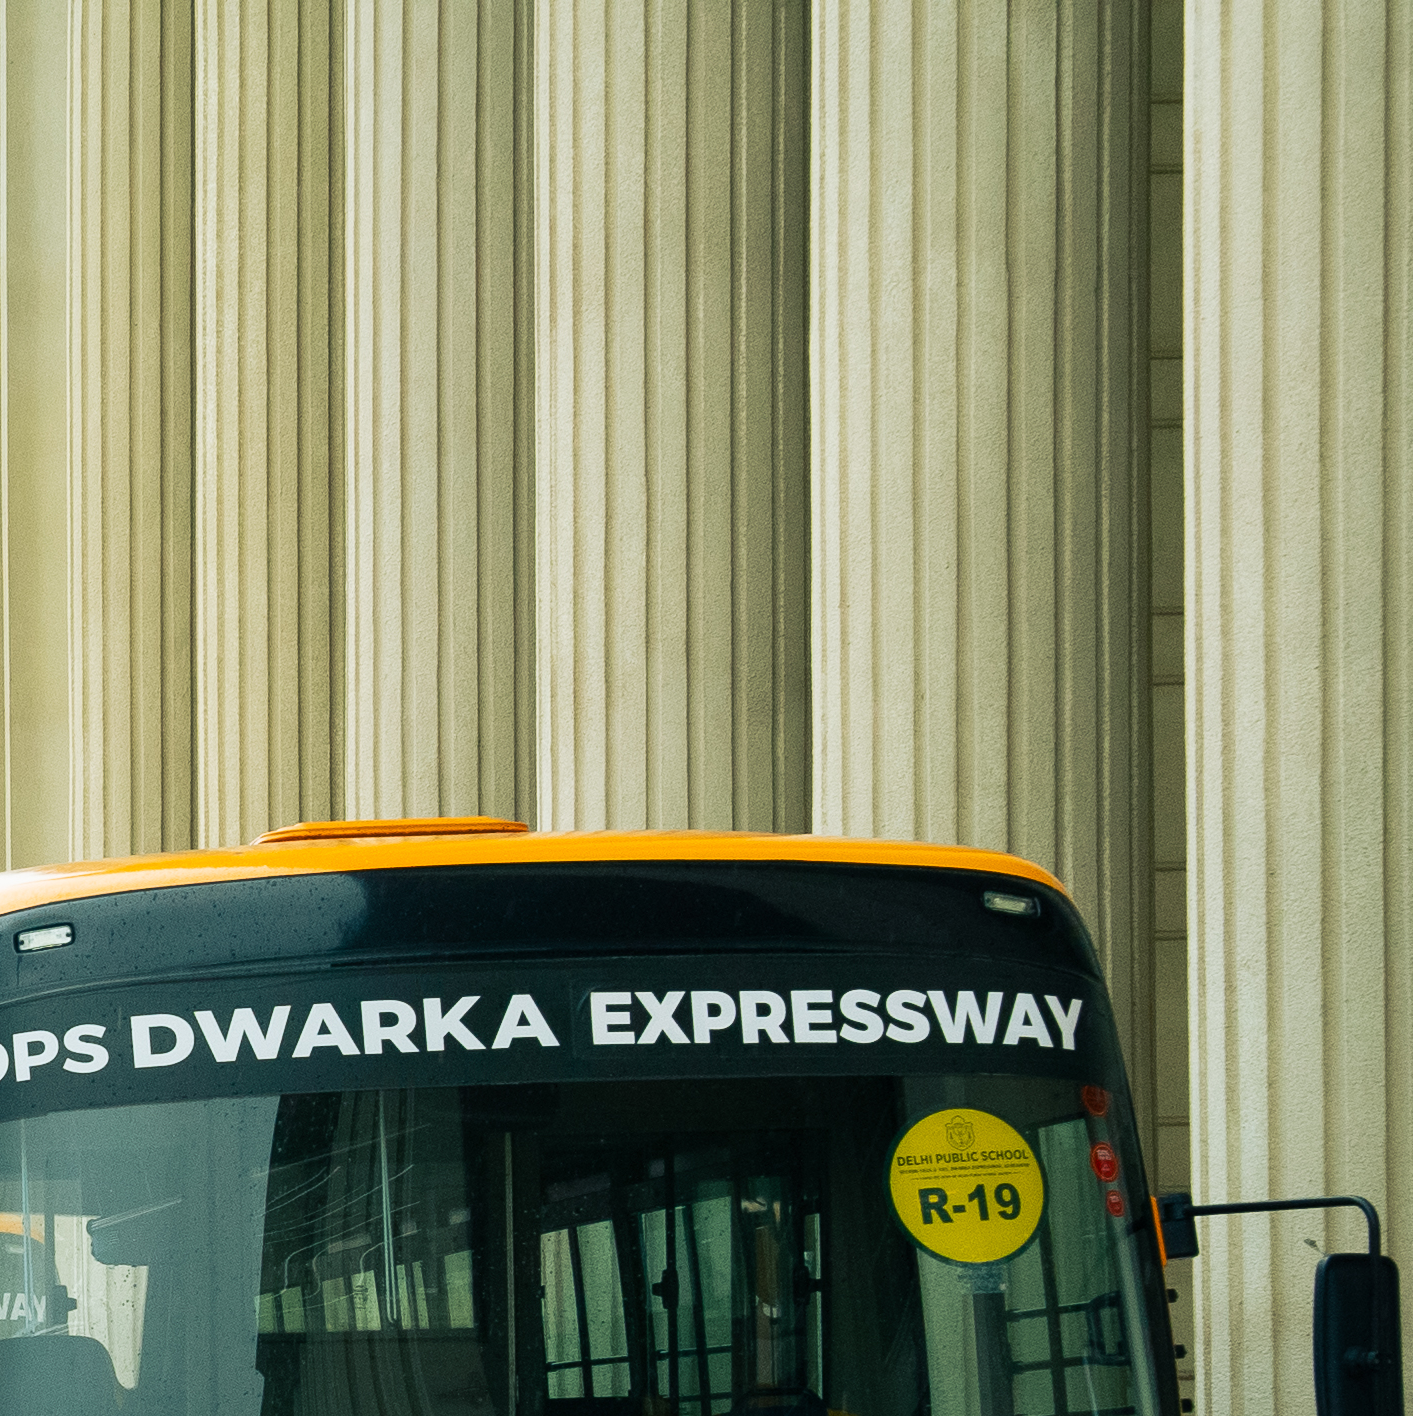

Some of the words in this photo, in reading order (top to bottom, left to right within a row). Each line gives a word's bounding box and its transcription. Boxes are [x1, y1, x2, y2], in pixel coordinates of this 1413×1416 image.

[130, 994, 560, 1069] DWARKA
[590, 989, 1083, 1050] EXPRESSWAY
[896, 1155, 933, 1167] DELHI
[935, 1151, 979, 1164] PUBLIC
[981, 1150, 1030, 1162] SCHOOL
[918, 1182, 1022, 1225] R-19
